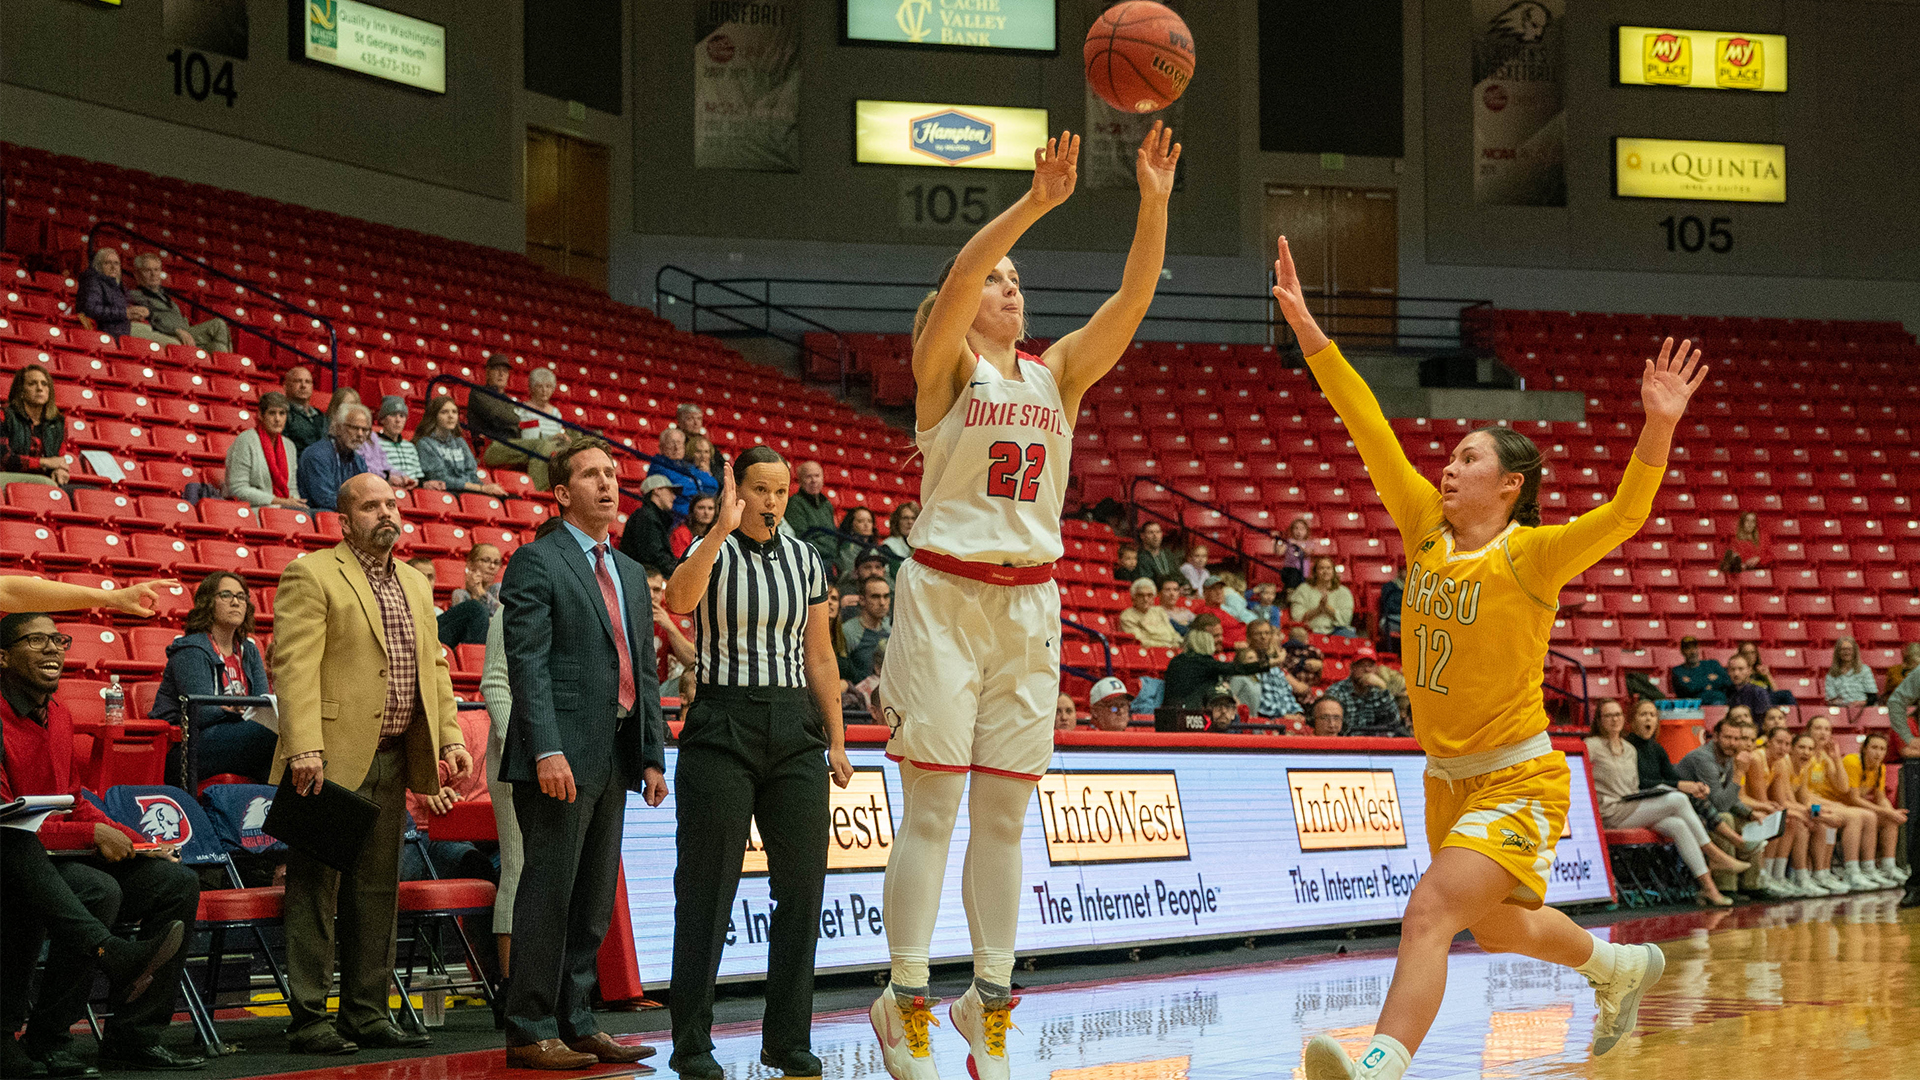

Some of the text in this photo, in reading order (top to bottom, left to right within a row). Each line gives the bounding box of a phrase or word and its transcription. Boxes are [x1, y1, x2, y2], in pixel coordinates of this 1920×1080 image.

[339, 9, 442, 47] Quality Inn Washington
[940, 10, 1007, 30] VALLEY
[941, 28, 990, 46] BANK
[354, 31, 427, 60] St George North
[1650, 36, 1682, 62] MY
[1722, 41, 1754, 66] MY
[166, 48, 239, 108] 104
[1647, 64, 1688, 77] PLACE
[1720, 68, 1760, 81] PLACE
[913, 121, 993, 145] Hampton
[1651, 151, 1779, 182] LA QUINTA
[906, 184, 989, 226] 105
[1660, 215, 1734, 254] 105
[965, 398, 1018, 428] DIXIE
[987, 441, 1047, 502] 22
[1414, 624, 1453, 695] 12
[1044, 786, 1181, 844] InfoWest
[1294, 783, 1400, 833] InfoWest
[1289, 865, 1320, 903] The
[1321, 868, 1380, 901] Internet
[1033, 881, 1074, 924] The
[1076, 882, 1152, 922] Internet
